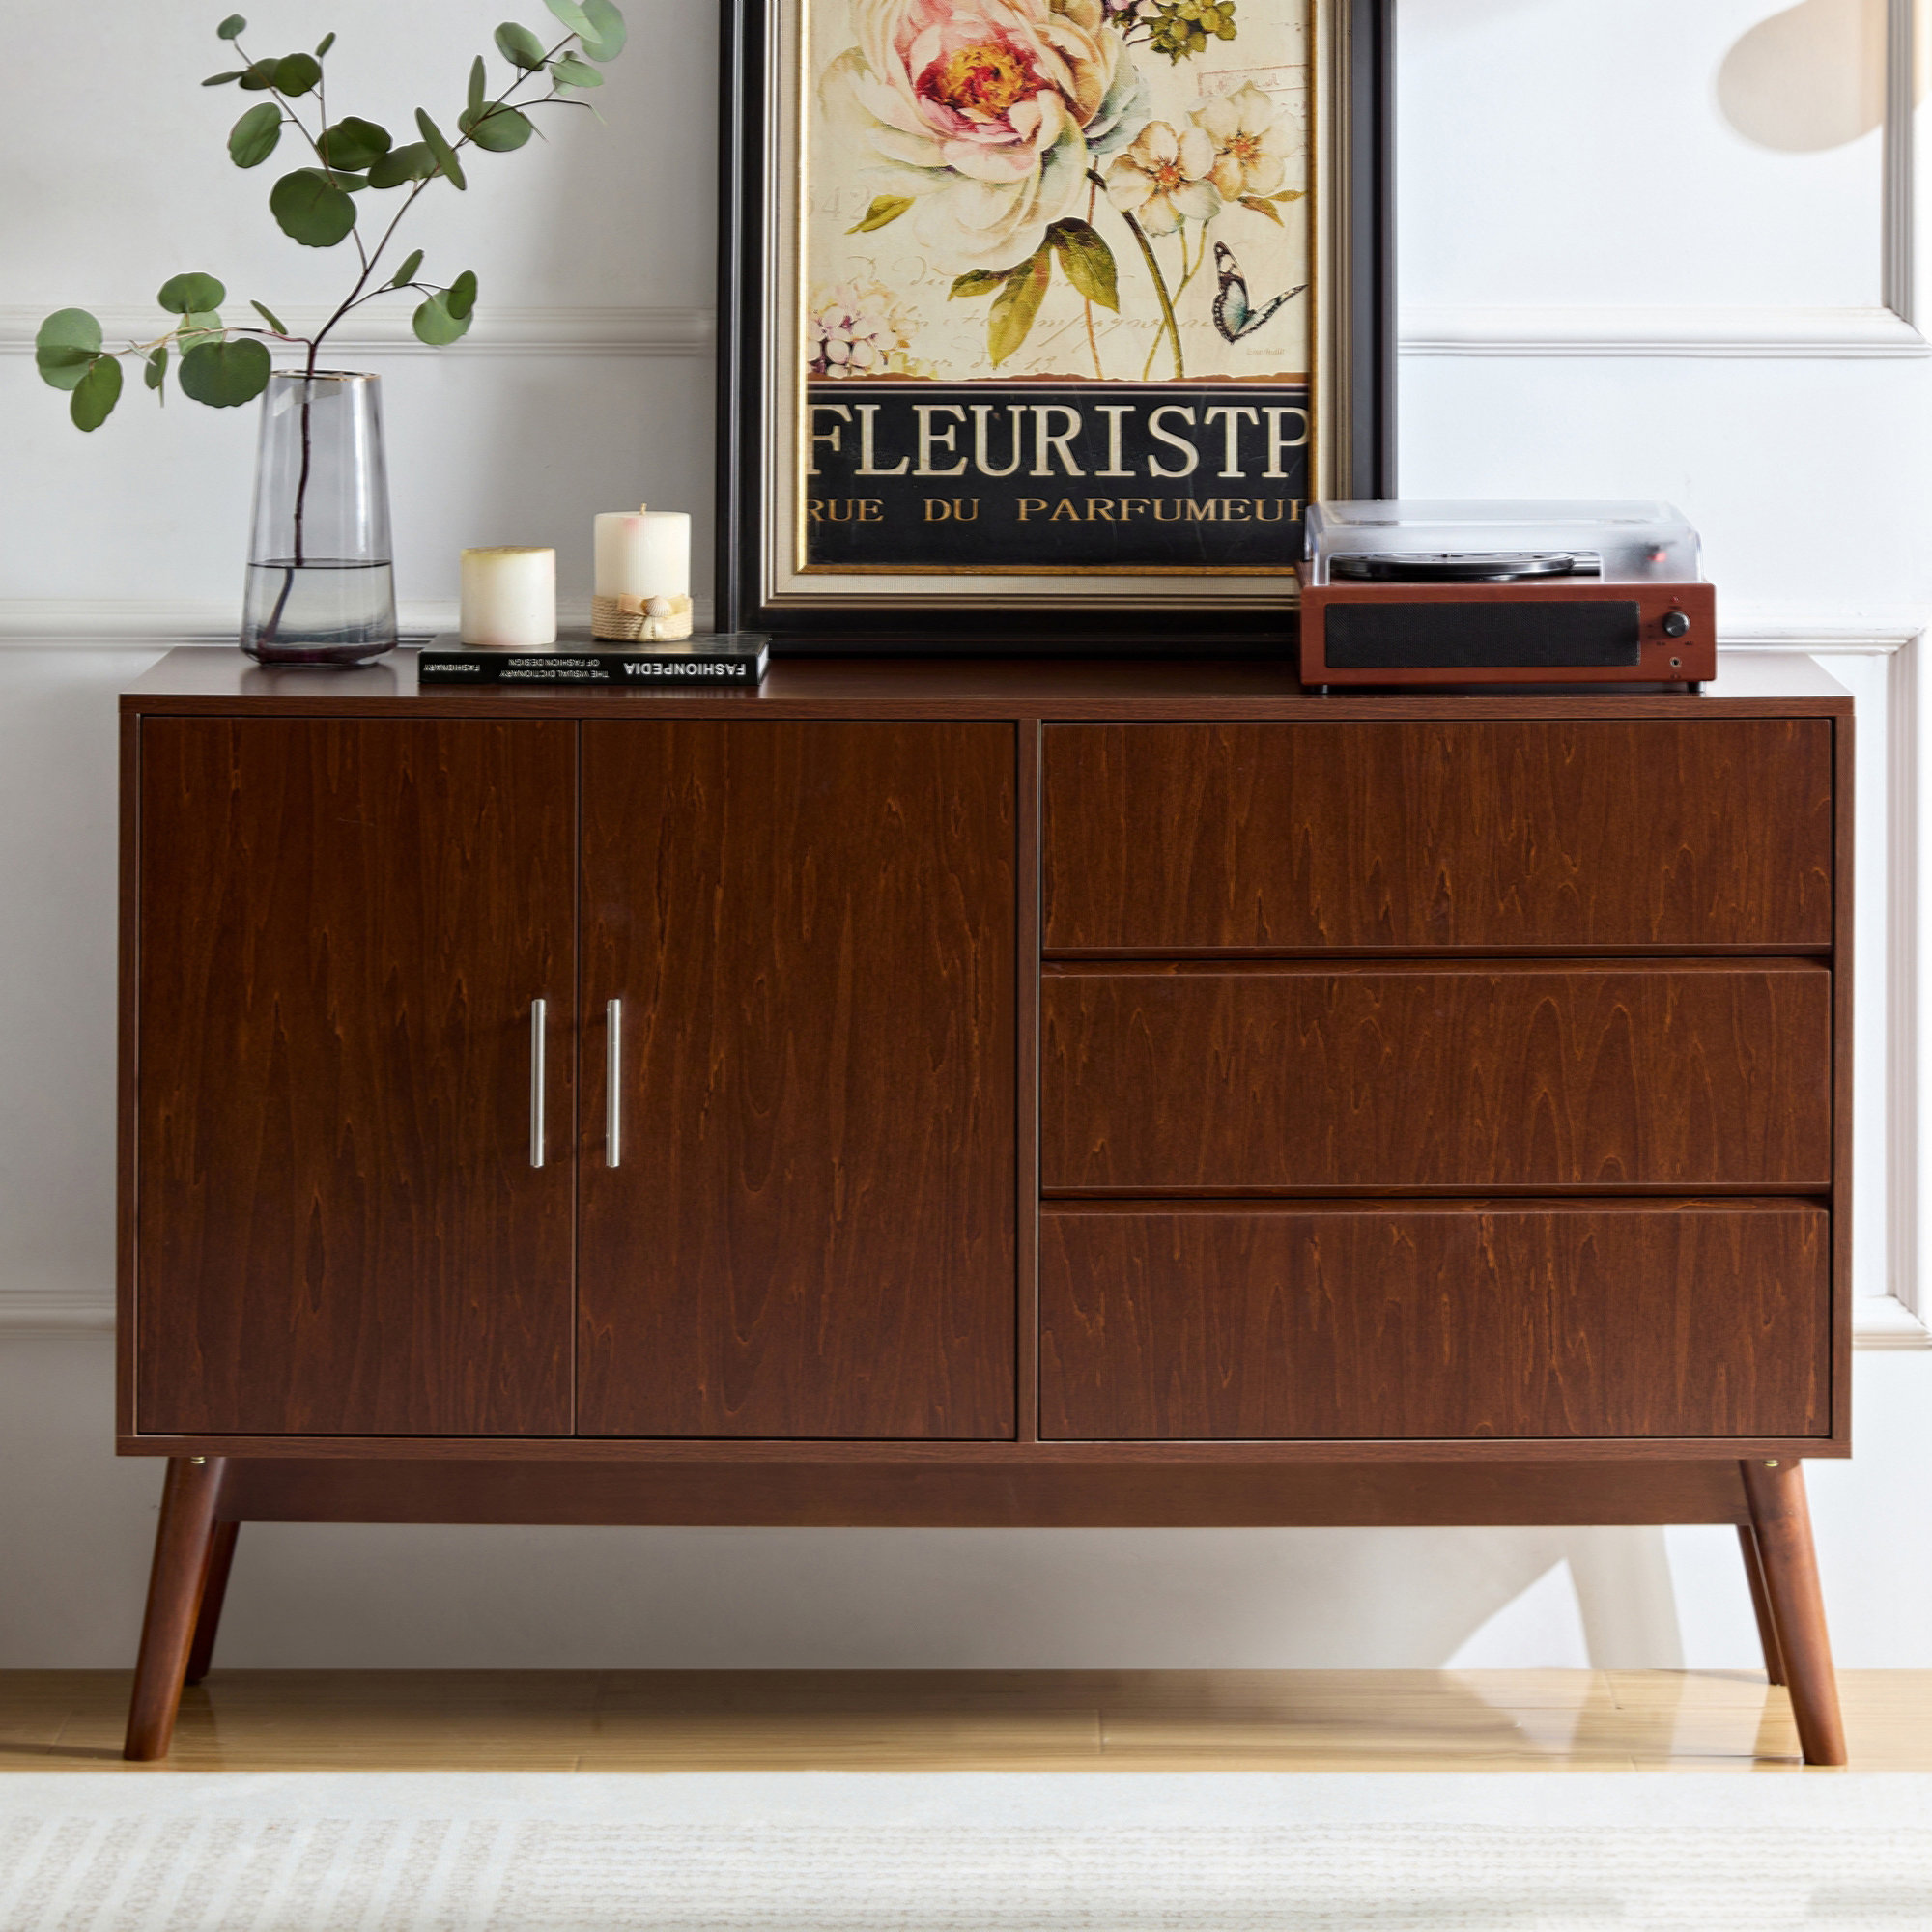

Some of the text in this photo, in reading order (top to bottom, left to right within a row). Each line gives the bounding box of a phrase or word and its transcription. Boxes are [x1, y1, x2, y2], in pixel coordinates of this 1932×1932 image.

[807, 403, 1309, 478] FLEURISTP
[806, 497, 885, 522] RUE
[923, 497, 980, 522] DU
[423, 664, 481, 672] FASHIONARY
[508, 658, 600, 667] OF FASHION DESIGN
[498, 669, 610, 678] THE VISUAL DICTIONARY
[623, 662, 747, 676] FASHIONPEDIA
